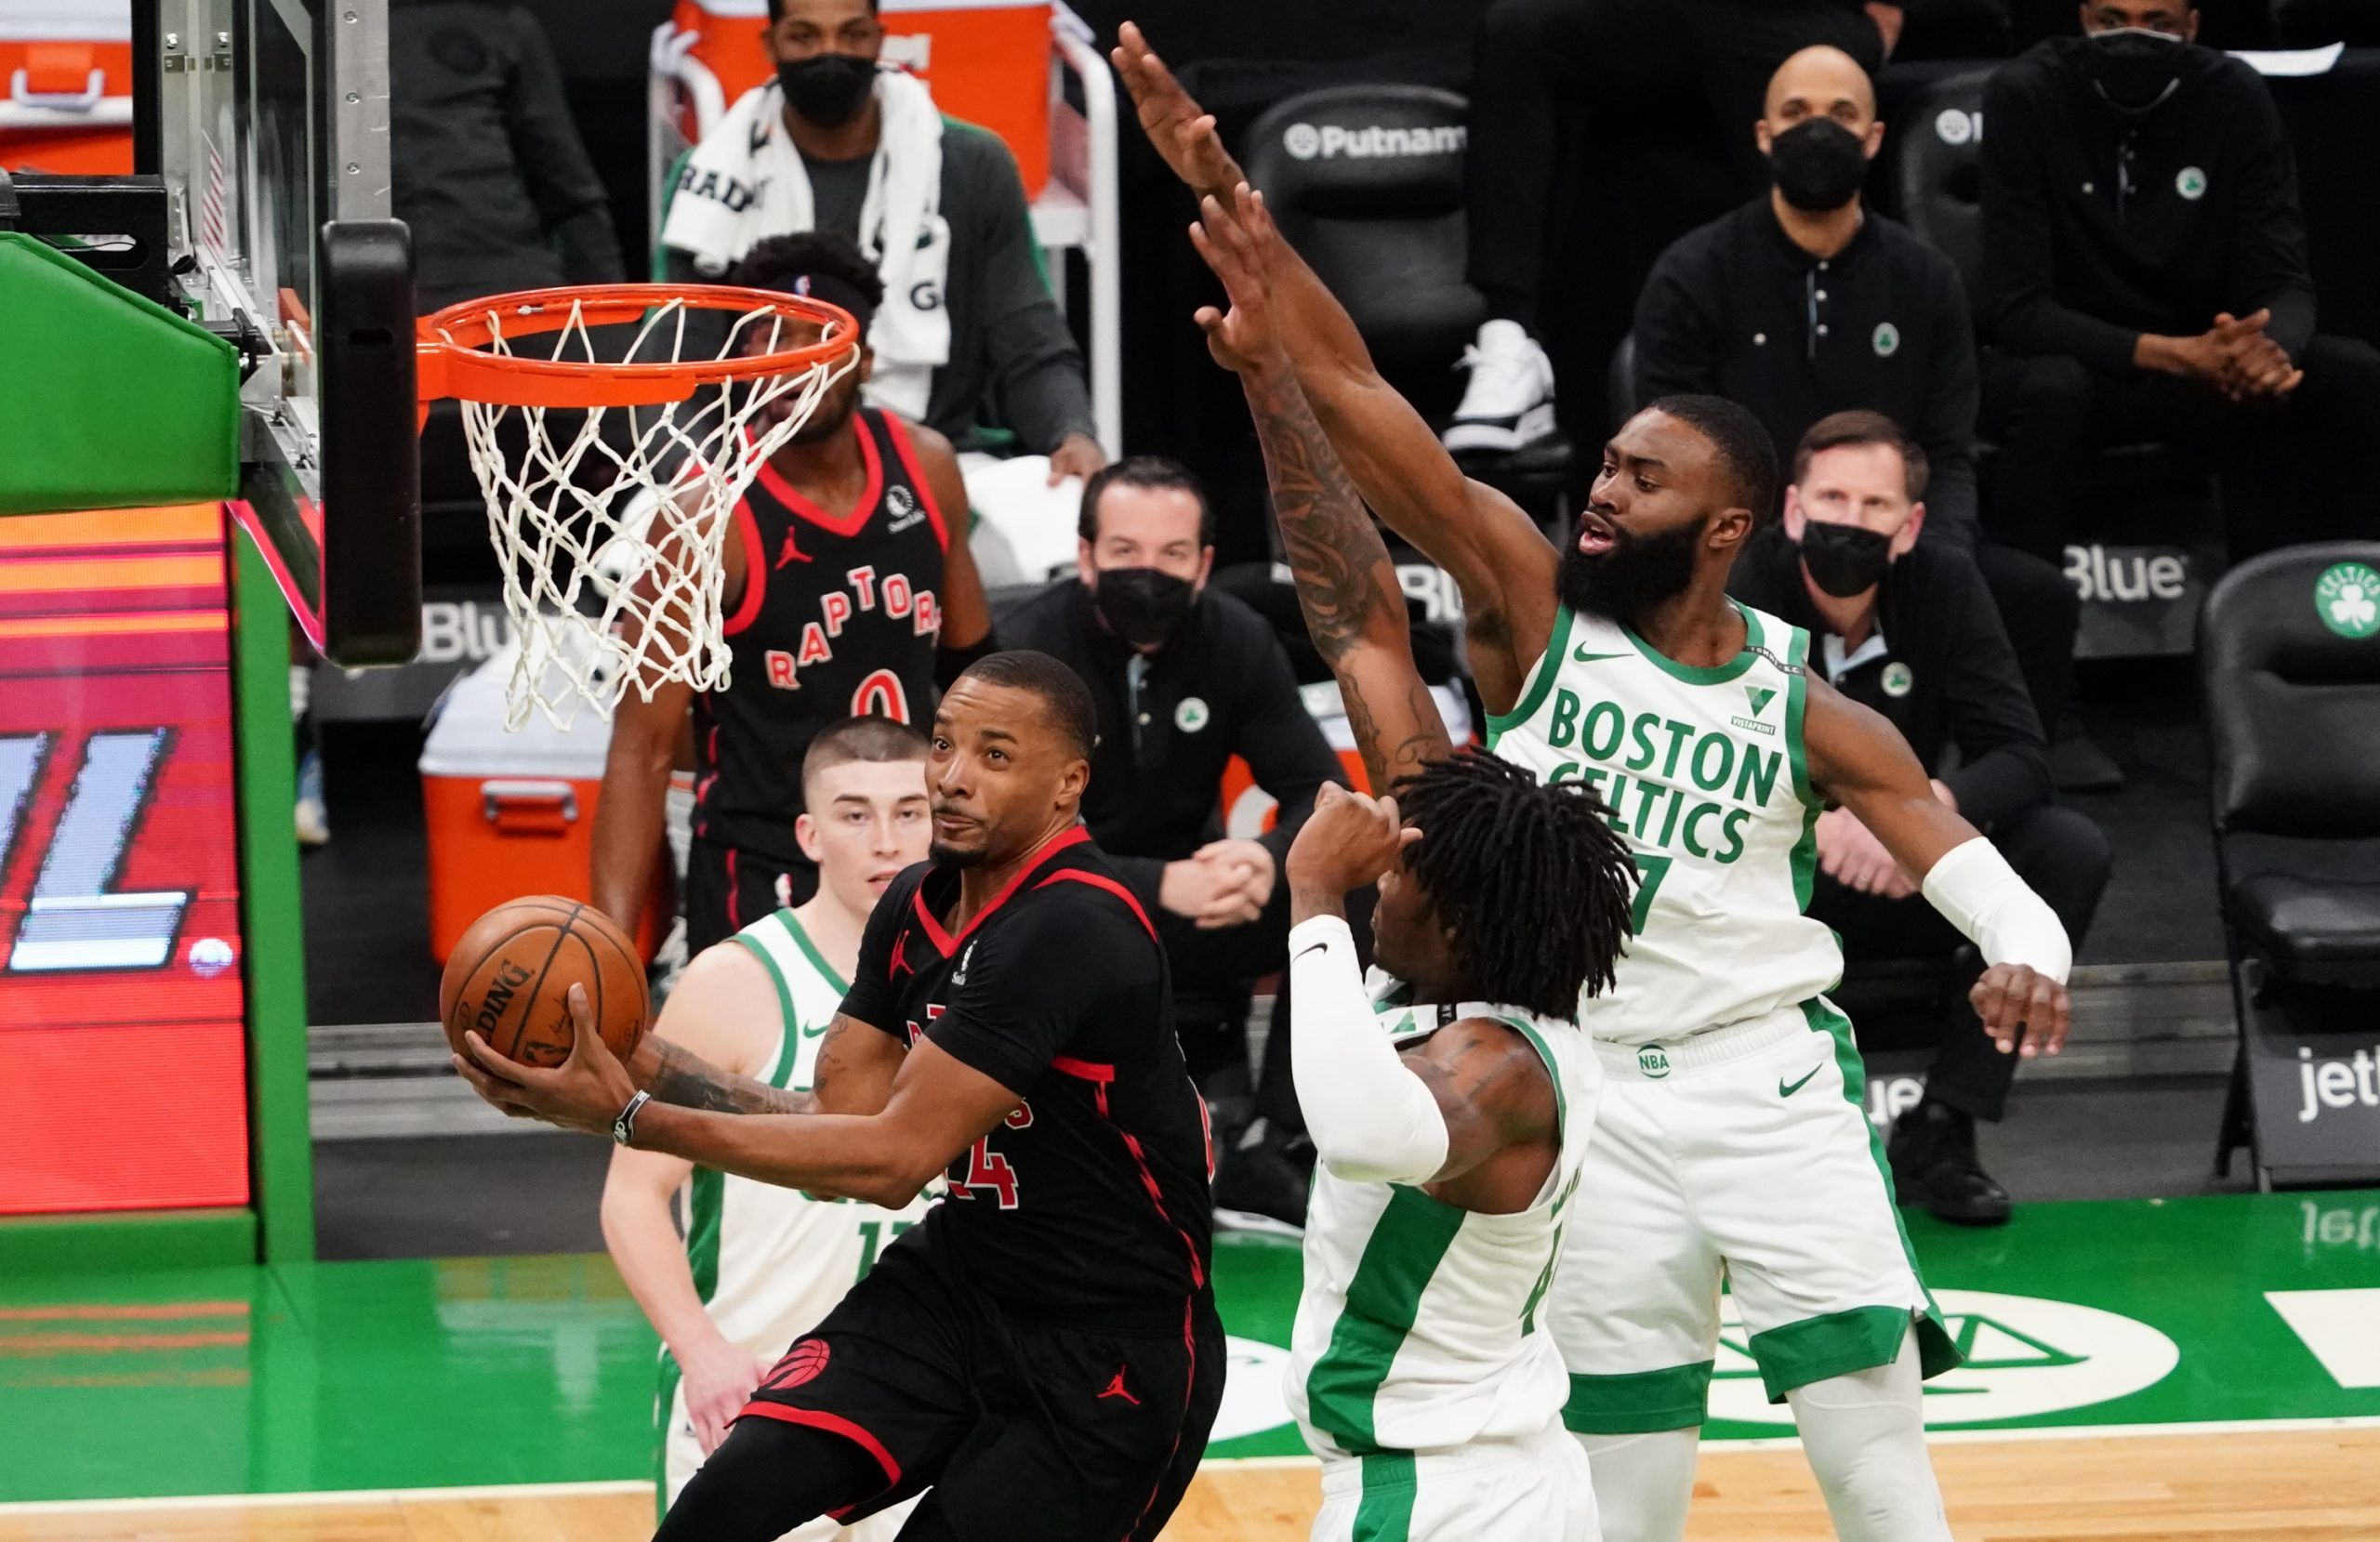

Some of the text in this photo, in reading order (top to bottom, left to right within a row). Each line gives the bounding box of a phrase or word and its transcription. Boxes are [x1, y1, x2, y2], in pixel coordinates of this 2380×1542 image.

[765, 565, 942, 691] RAPTOR
[1548, 687, 1783, 808] BOSTON
[1731, 716, 1776, 735] VISTAPRINT
[1548, 762, 1752, 864] LTICS
[1631, 851, 1673, 936] 7
[1638, 1054, 1671, 1070] NBA
[2297, 1046, 2380, 1123] jet
